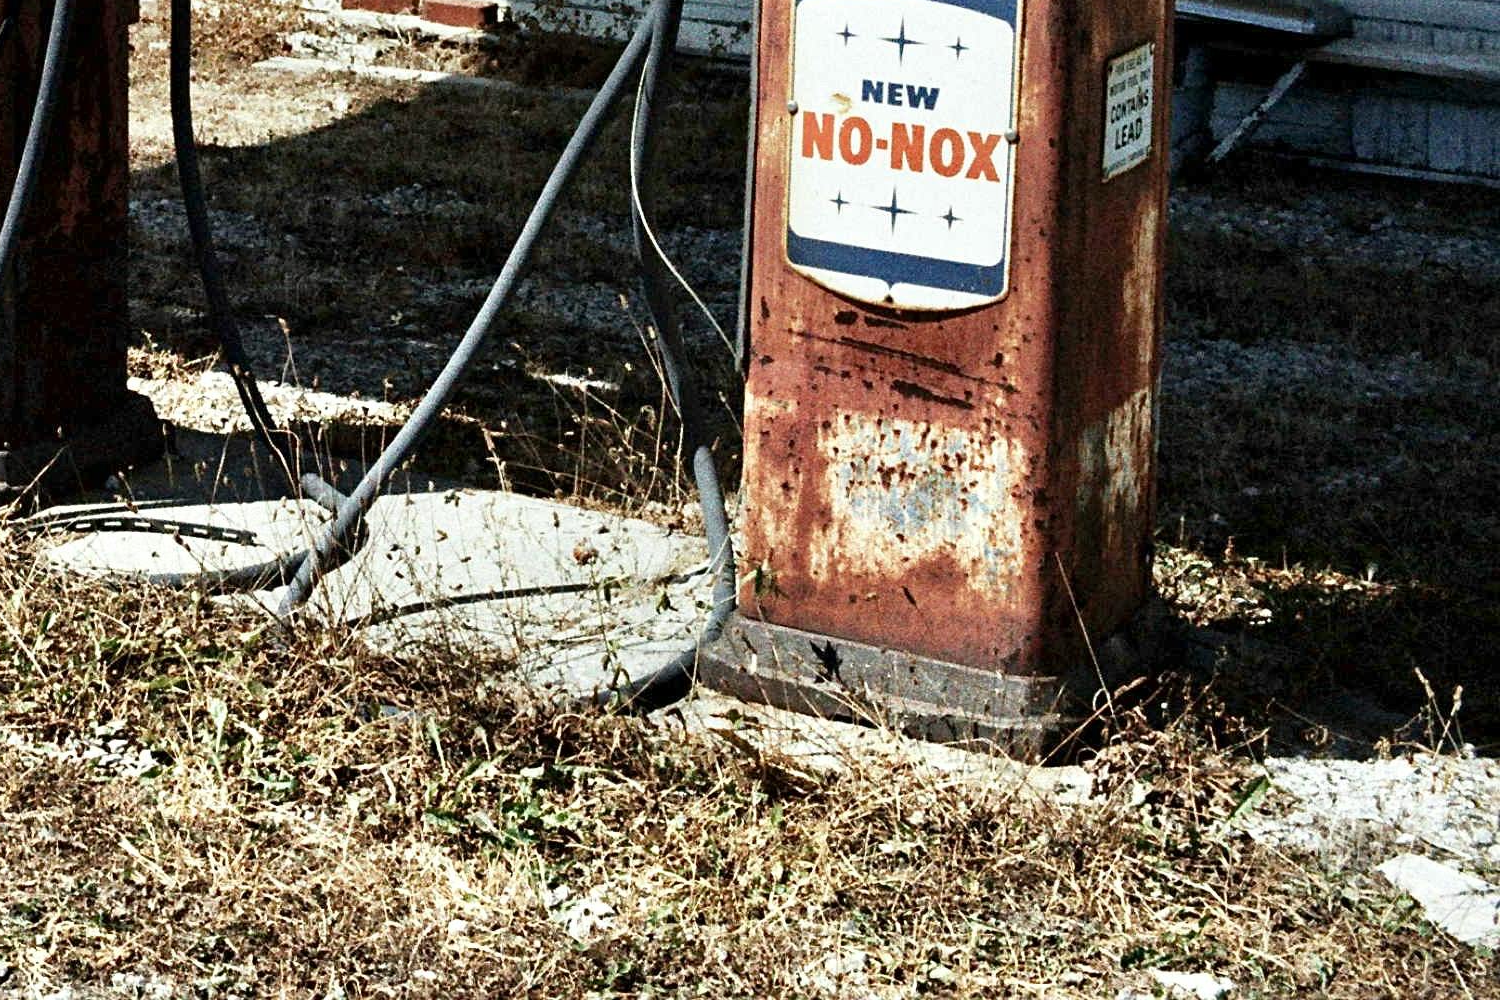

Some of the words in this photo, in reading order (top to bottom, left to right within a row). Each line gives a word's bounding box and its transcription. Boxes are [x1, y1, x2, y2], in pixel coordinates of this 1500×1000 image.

[861, 79, 940, 111] NEW
[1110, 89, 1149, 124] CONTAINS
[802, 111, 1001, 183] NO-NOX
[1115, 117, 1143, 150] LEAD
